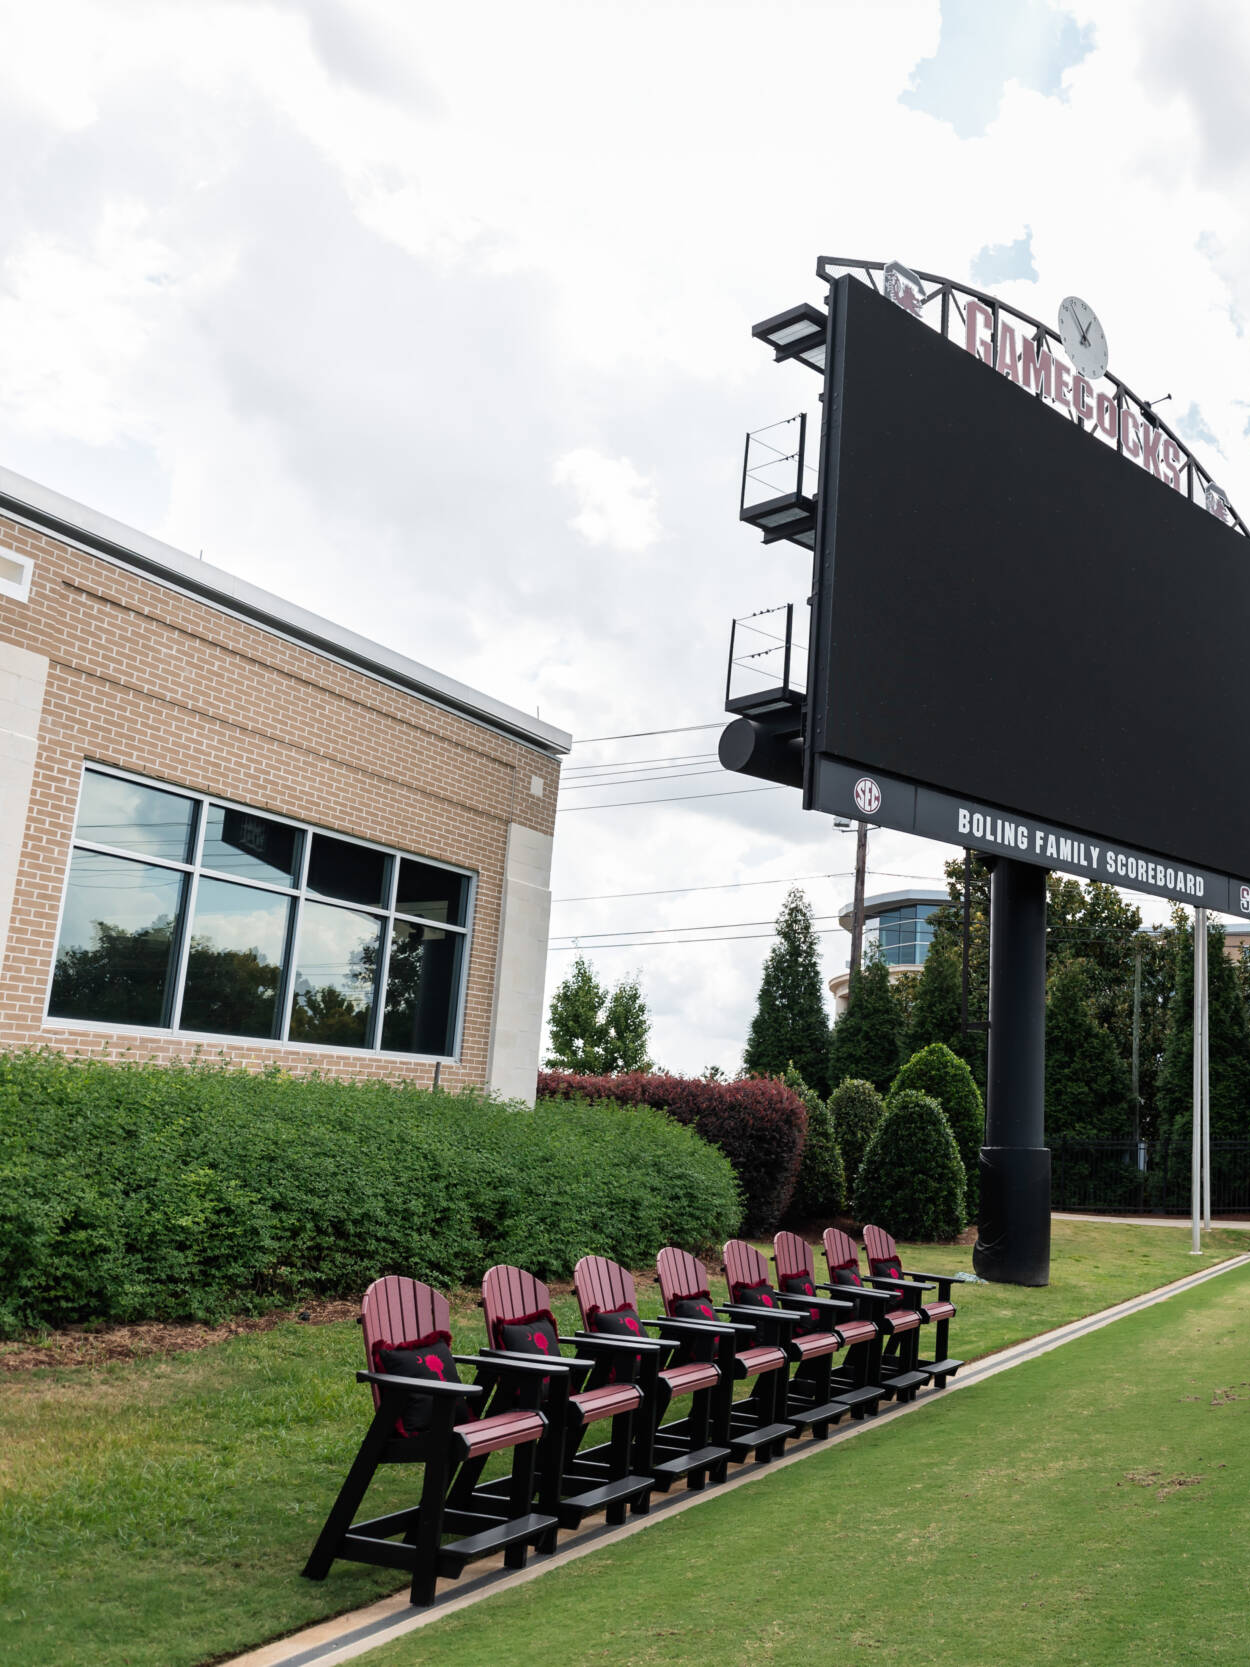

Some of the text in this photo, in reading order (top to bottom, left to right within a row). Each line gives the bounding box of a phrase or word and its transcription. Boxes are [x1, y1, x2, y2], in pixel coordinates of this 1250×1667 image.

[965, 299, 1183, 491] GAMECOCKS
[856, 779, 880, 812] SEC
[958, 808, 1205, 897] BOLING FAMILY SCOREBOARD
